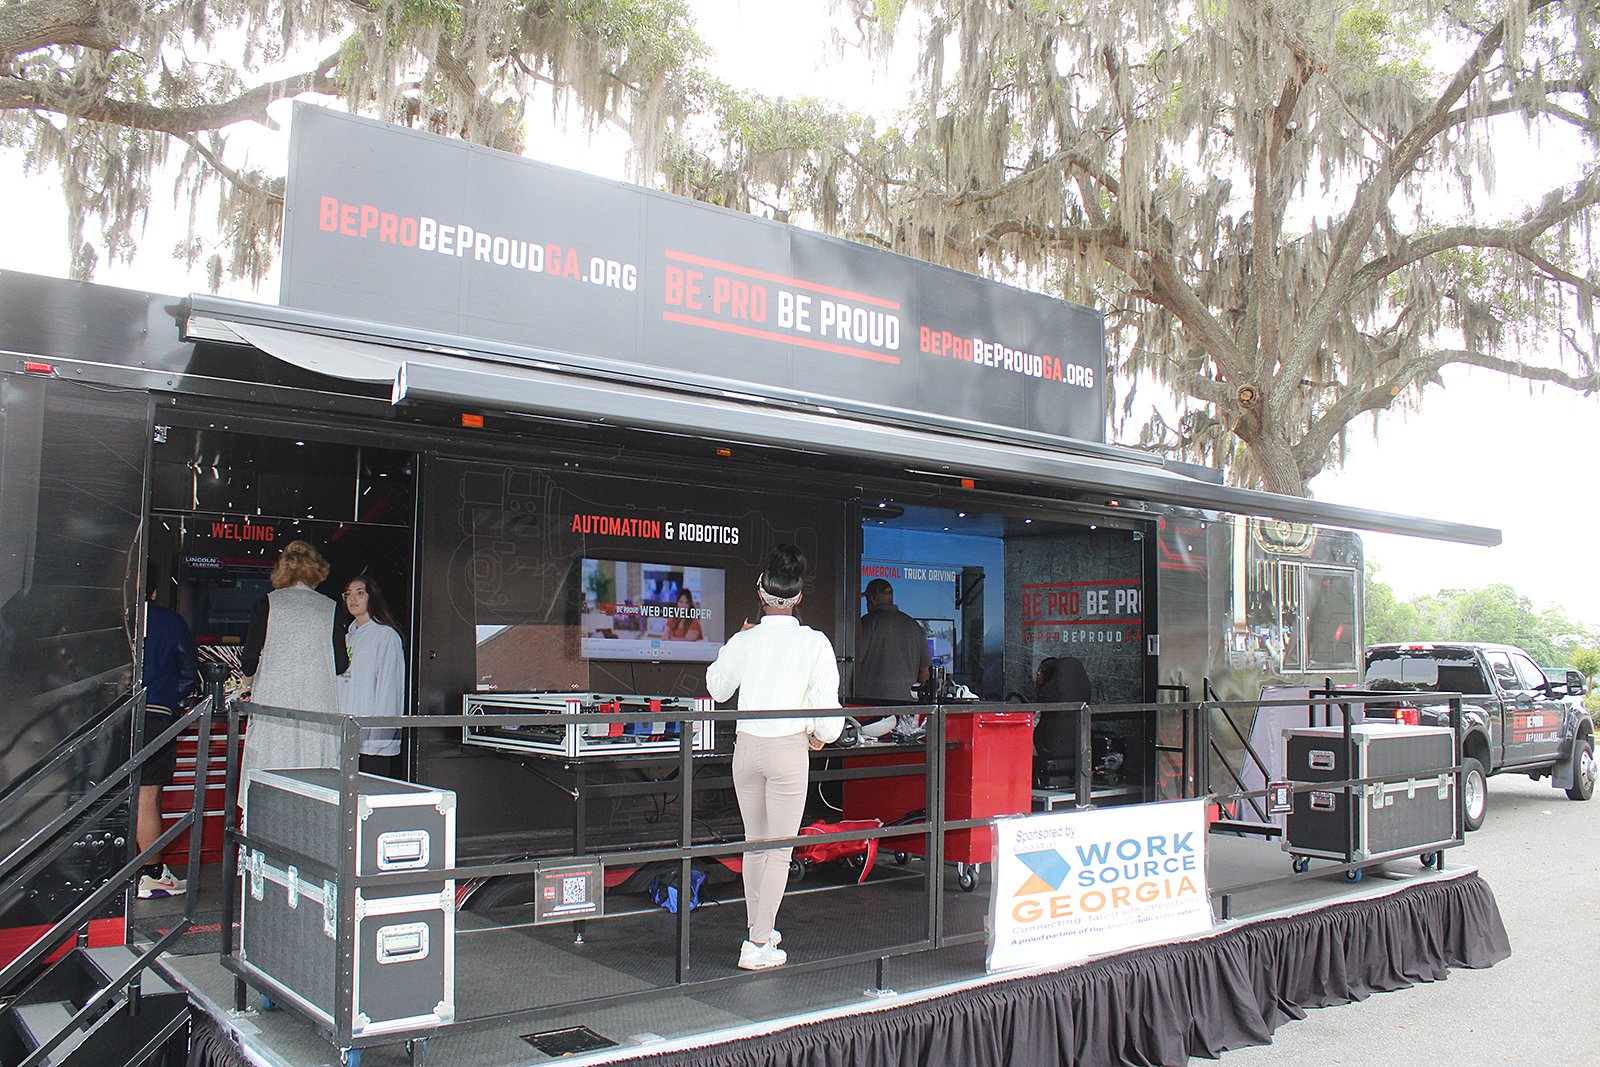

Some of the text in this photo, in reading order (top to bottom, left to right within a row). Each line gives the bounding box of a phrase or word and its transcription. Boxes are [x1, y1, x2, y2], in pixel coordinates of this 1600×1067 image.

[664, 265, 901, 351] BE PRO BE PROUD
[211, 522, 275, 542] WELDING
[571, 514, 740, 545] AUTOMATION & ROBOTICS
[903, 567, 927, 580] TRUCK
[928, 569, 956, 582] DRIVING
[640, 605, 661, 617] WEB
[662, 606, 712, 620] DEVELOPER
[1021, 588, 1142, 617] BE PRO BE PR
[1016, 824, 1075, 844] Sponsored by
[1075, 831, 1194, 867] WORK
[1077, 855, 1196, 887] SOURCE
[1011, 875, 1198, 923] GEORGIA
[1012, 918, 1082, 934] Connecting
[1019, 934, 1045, 945] proud
[1045, 930, 1077, 940] partner
[1078, 927, 1089, 935] of
